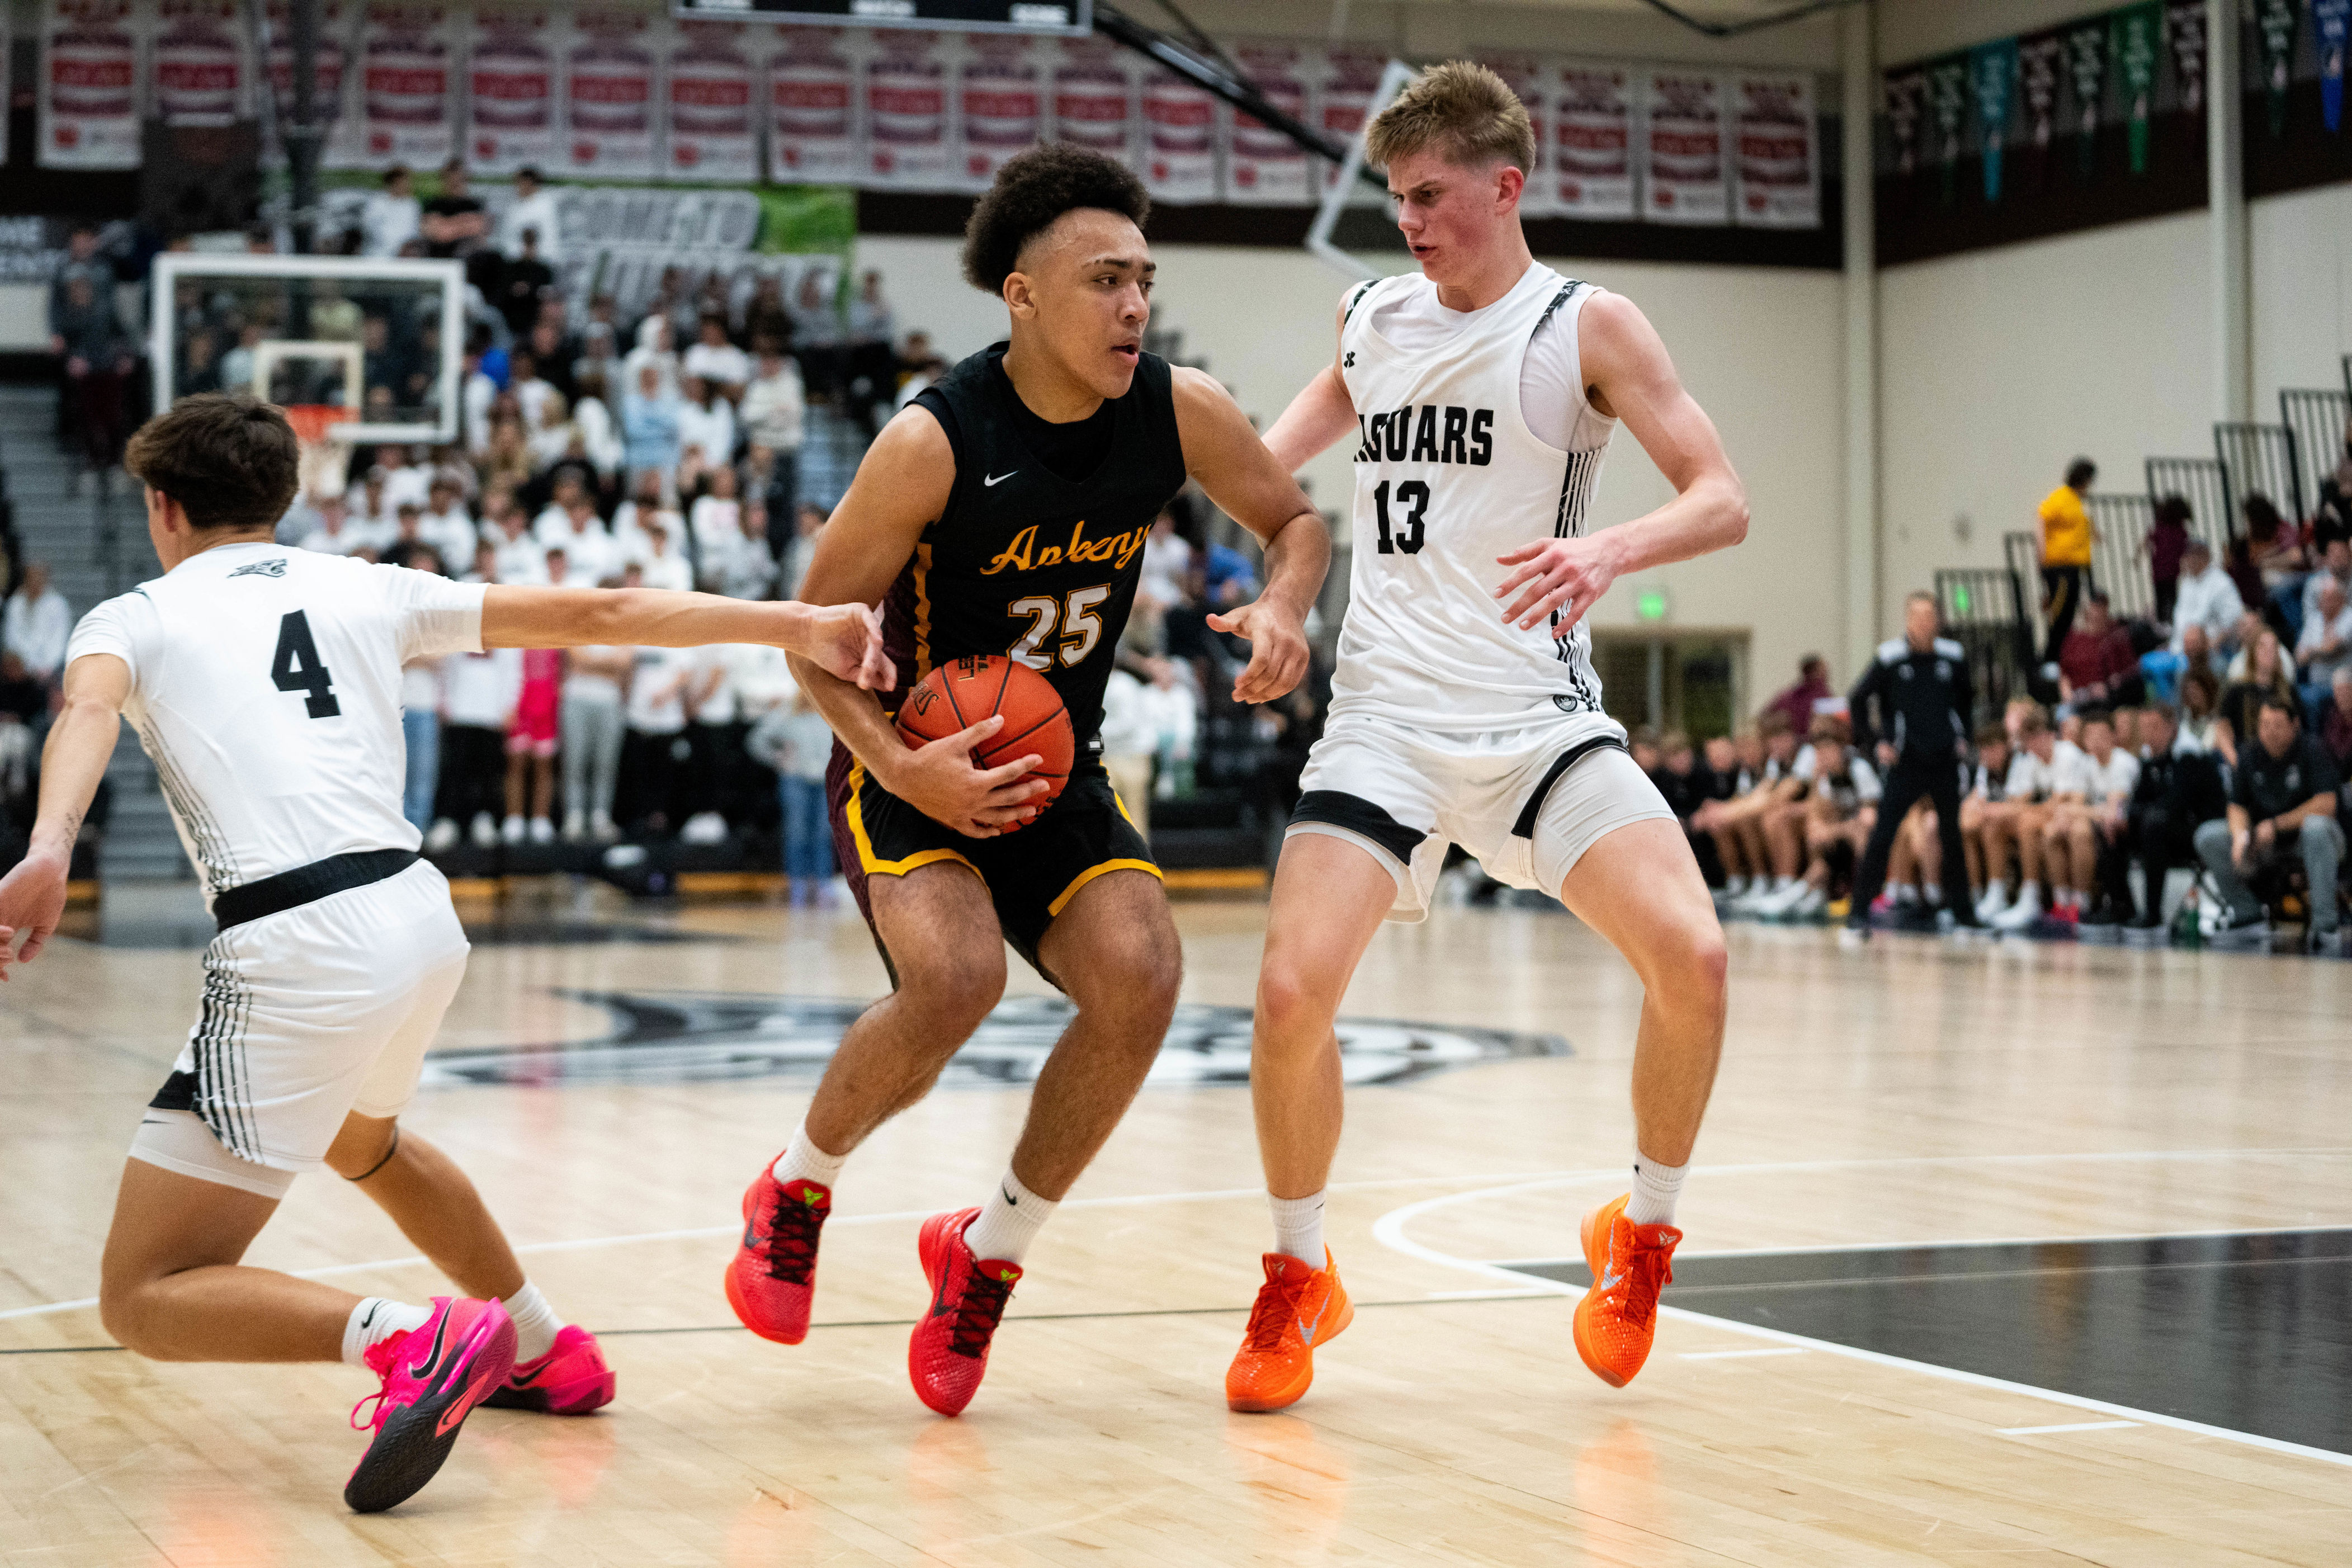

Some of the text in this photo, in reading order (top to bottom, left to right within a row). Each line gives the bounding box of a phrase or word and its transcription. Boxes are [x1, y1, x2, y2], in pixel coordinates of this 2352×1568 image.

[979, 519, 1151, 575] Ankeny
[1374, 480, 1430, 555] 13
[271, 608, 342, 719] 4
[1007, 583, 1111, 672] 25
